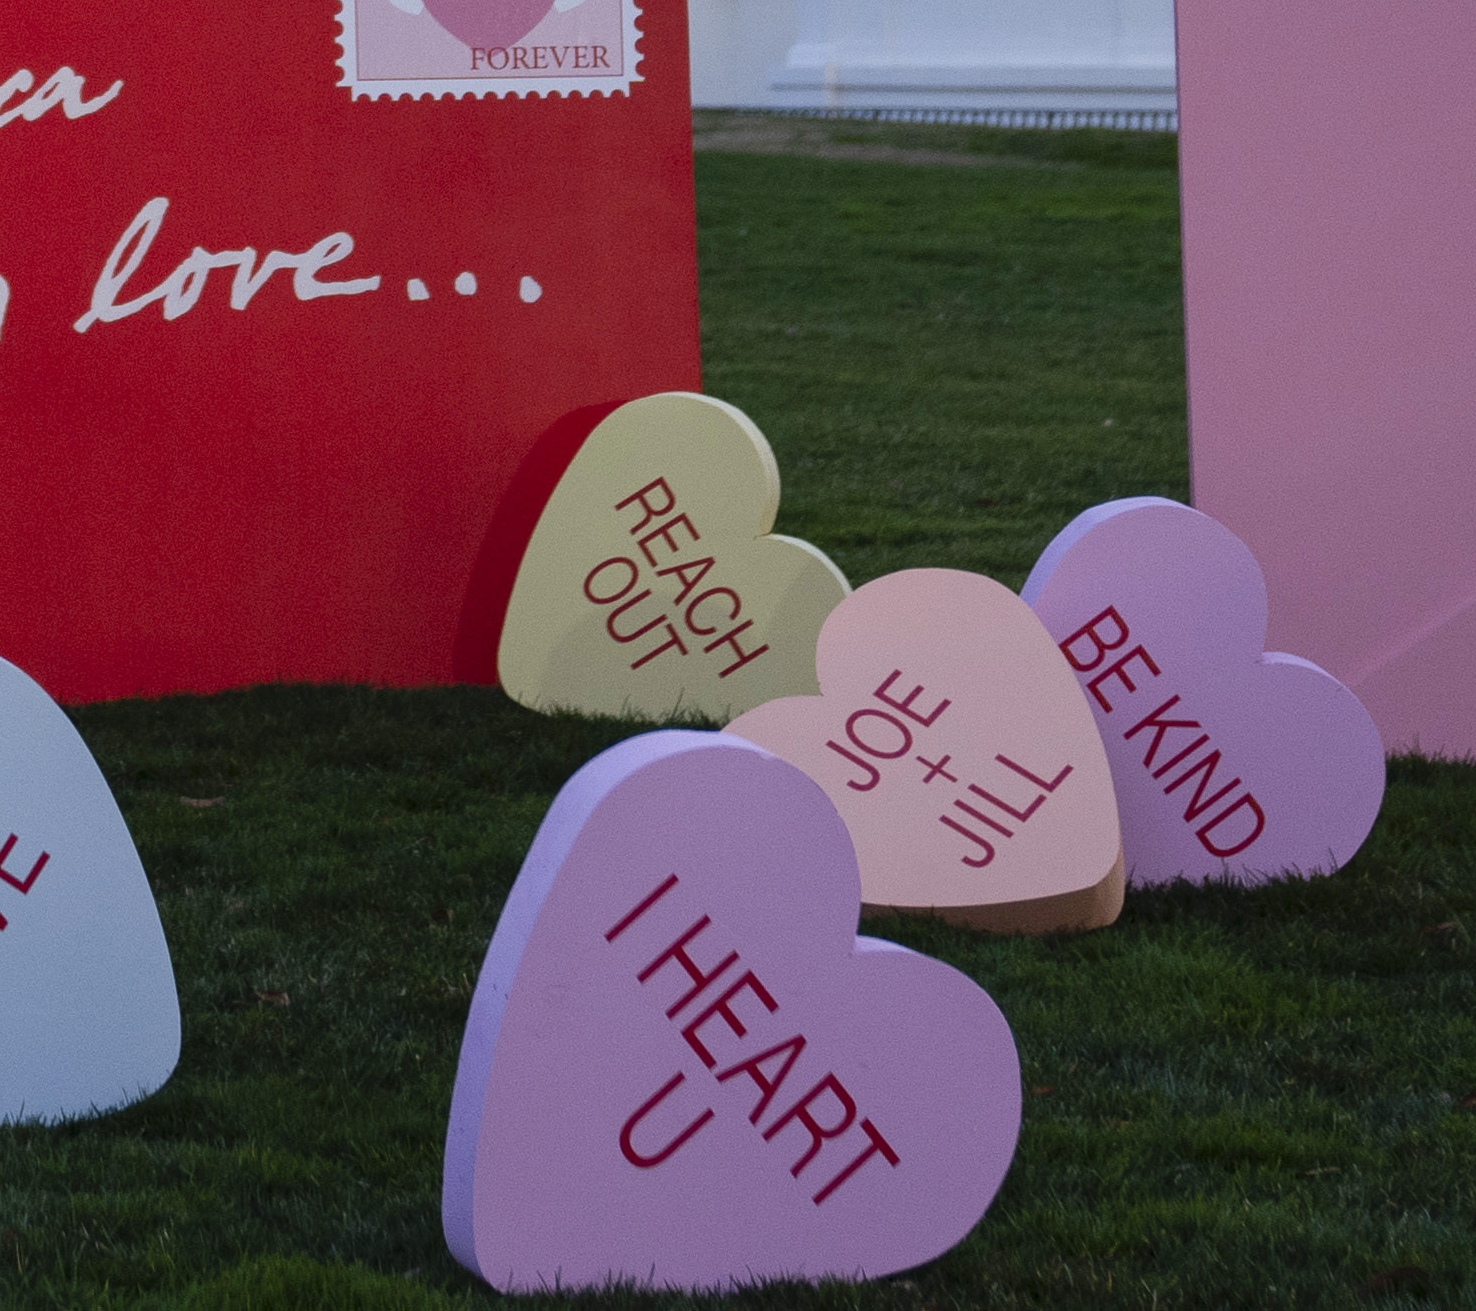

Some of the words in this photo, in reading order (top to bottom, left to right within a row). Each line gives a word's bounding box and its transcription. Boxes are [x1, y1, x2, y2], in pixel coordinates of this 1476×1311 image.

[470, 45, 611, 71] FOREVER
[72, 196, 544, 335] love...
[581, 555, 689, 671] OUT
[613, 475, 770, 680] REACH
[824, 668, 952, 793] JOE
[1056, 605, 1161, 714] BE
[1123, 694, 1267, 861] KIND
[938, 753, 1075, 870] JILL
[605, 874, 680, 943] I
[635, 914, 902, 1207] HEART
[617, 1072, 716, 1171] U
